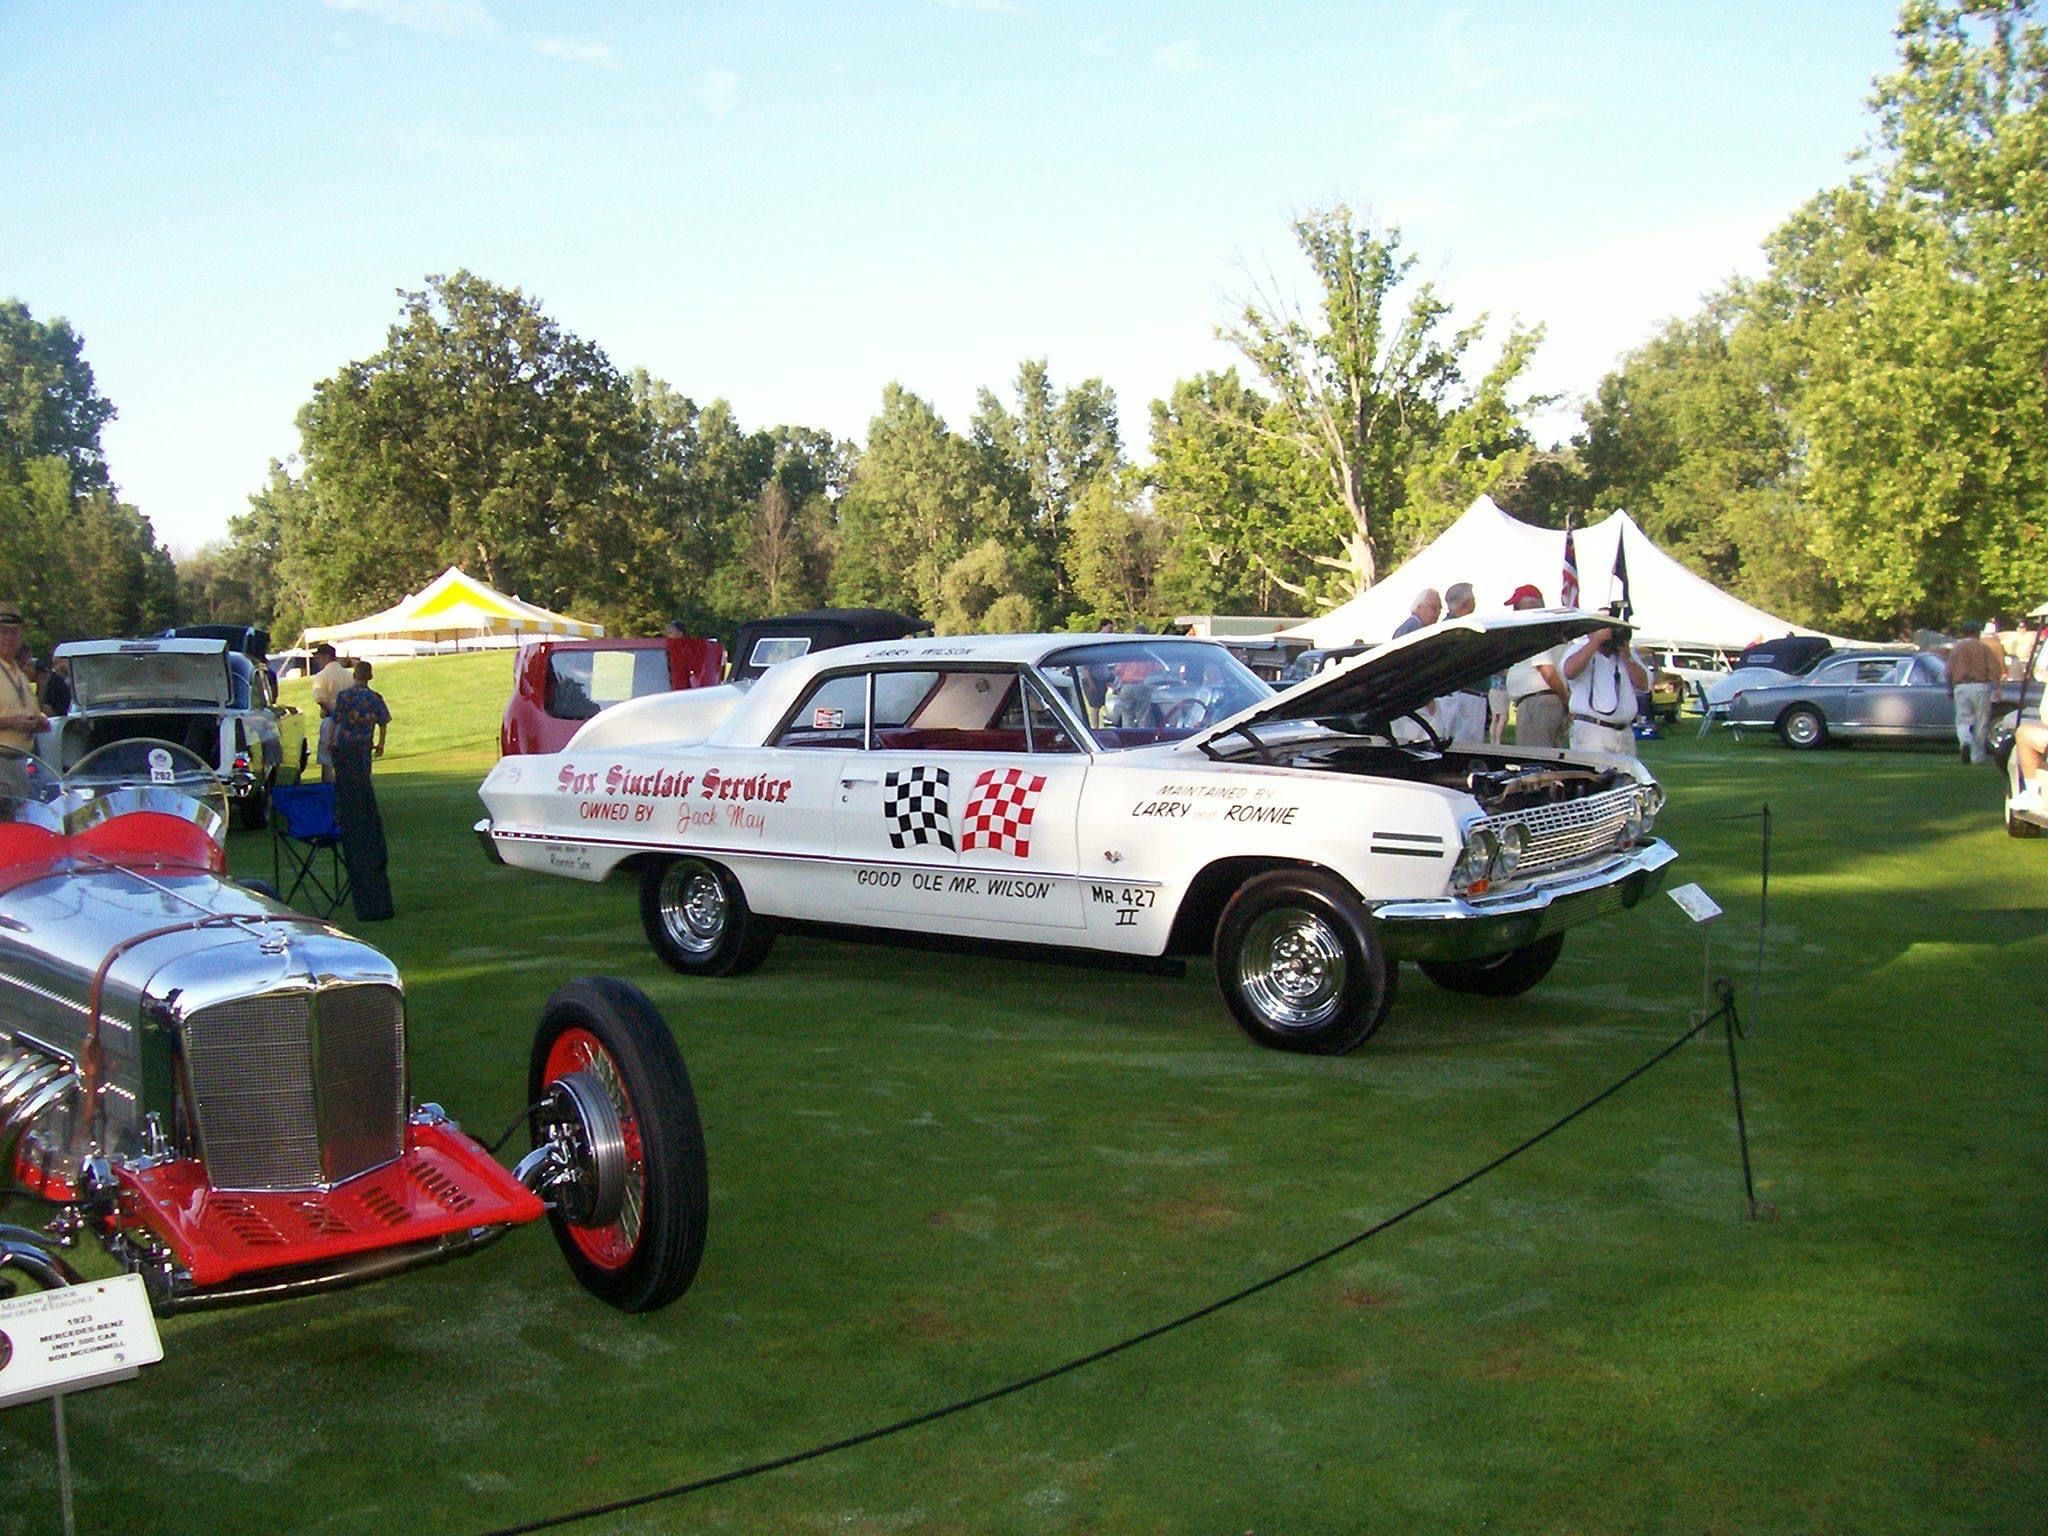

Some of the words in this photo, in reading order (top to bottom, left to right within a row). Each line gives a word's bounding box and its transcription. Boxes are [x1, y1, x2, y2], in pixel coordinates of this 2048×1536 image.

[558, 764, 598, 794] Sox
[606, 764, 695, 798] Sinclair
[702, 768, 792, 803] Service
[1157, 785, 1248, 799] MAINTAINED
[580, 801, 629, 821] OWNED
[635, 804, 654, 822] BY
[677, 802, 716, 834] Jack
[727, 804, 766, 838] May
[1132, 801, 1192, 818] LARRY
[1224, 804, 1299, 825] RONNIE
[912, 873, 943, 891] OLE
[949, 877, 980, 895] MR.
[1121, 888, 1156, 908] 427
[1115, 909, 1139, 926] II
[67, 1315, 93, 1326] 1923
[52, 1341, 75, 1351] INDY
[97, 1332, 117, 1341] CAR
[48, 1353, 68, 1362] BOB
